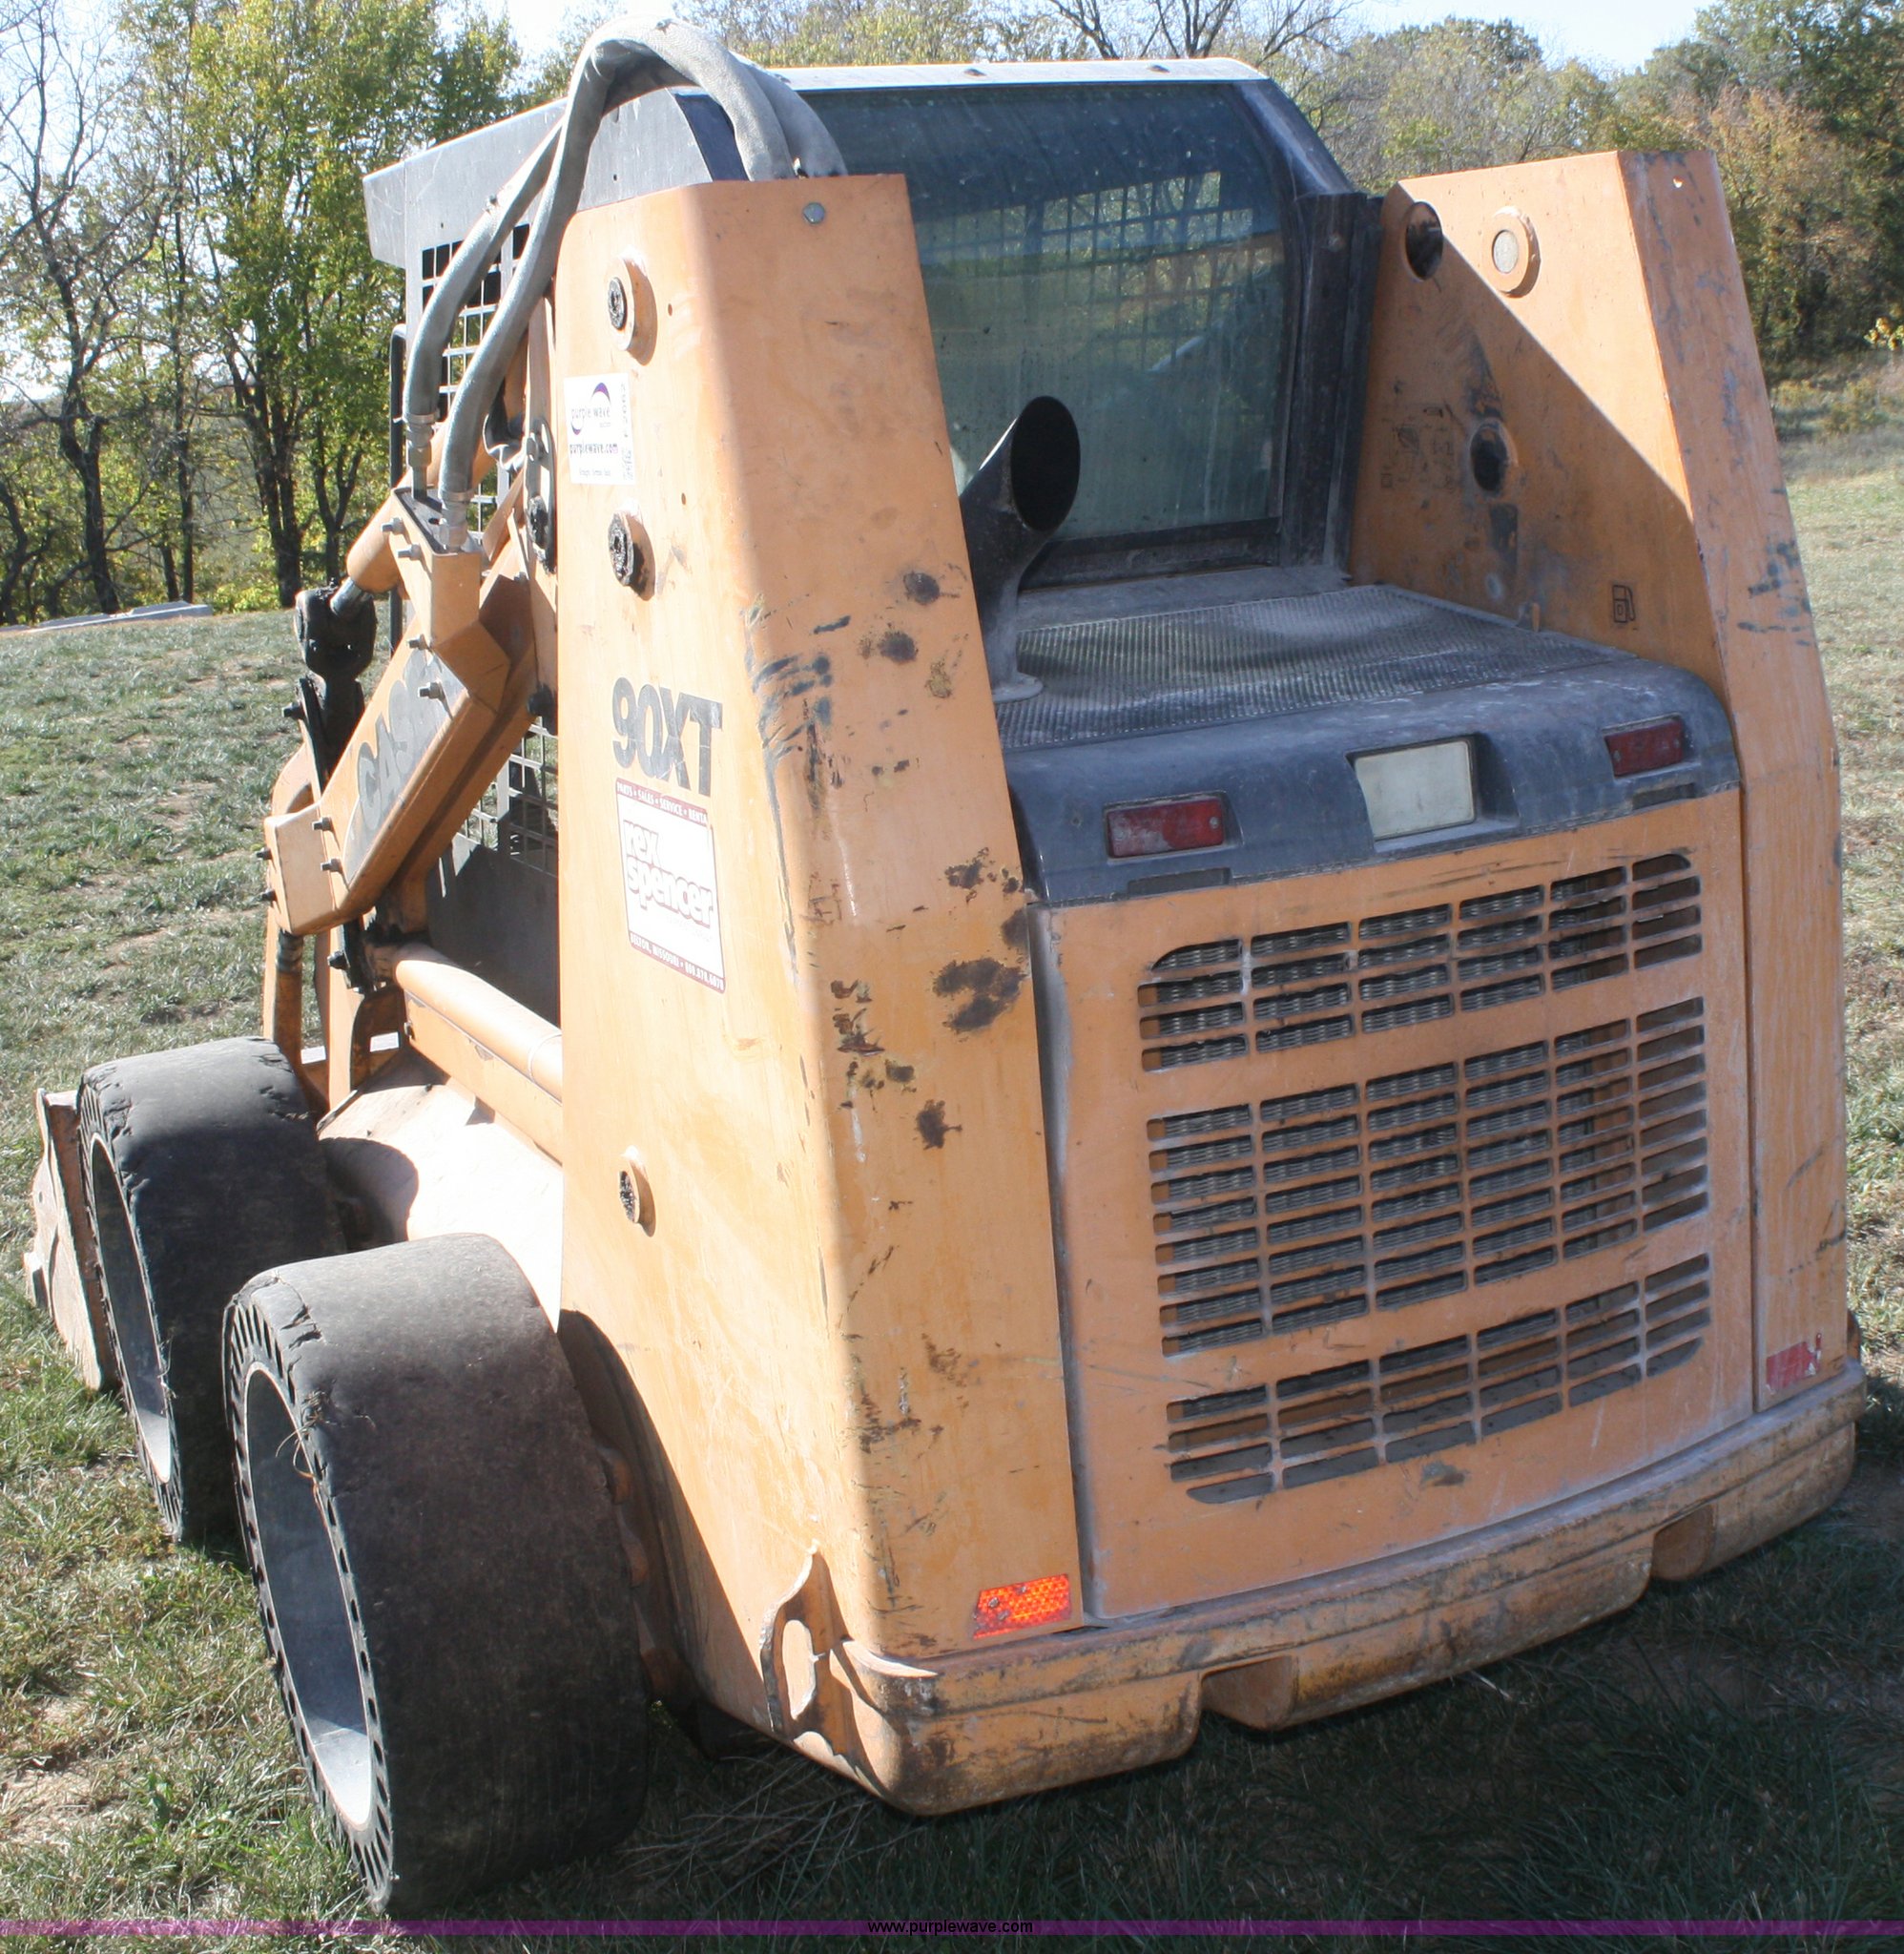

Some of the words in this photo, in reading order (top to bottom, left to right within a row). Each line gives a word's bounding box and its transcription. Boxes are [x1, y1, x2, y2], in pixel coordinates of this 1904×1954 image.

[570, 405, 591, 420] purple
[592, 405, 611, 418] wave
[569, 442, 618, 458] purplewave.com
[612, 676, 723, 798] 90XT
[616, 781, 633, 796] PARTS
[637, 789, 654, 805] SALES
[658, 798, 684, 817] SERVICE
[623, 820, 661, 866] rex
[626, 855, 714, 929] spencer
